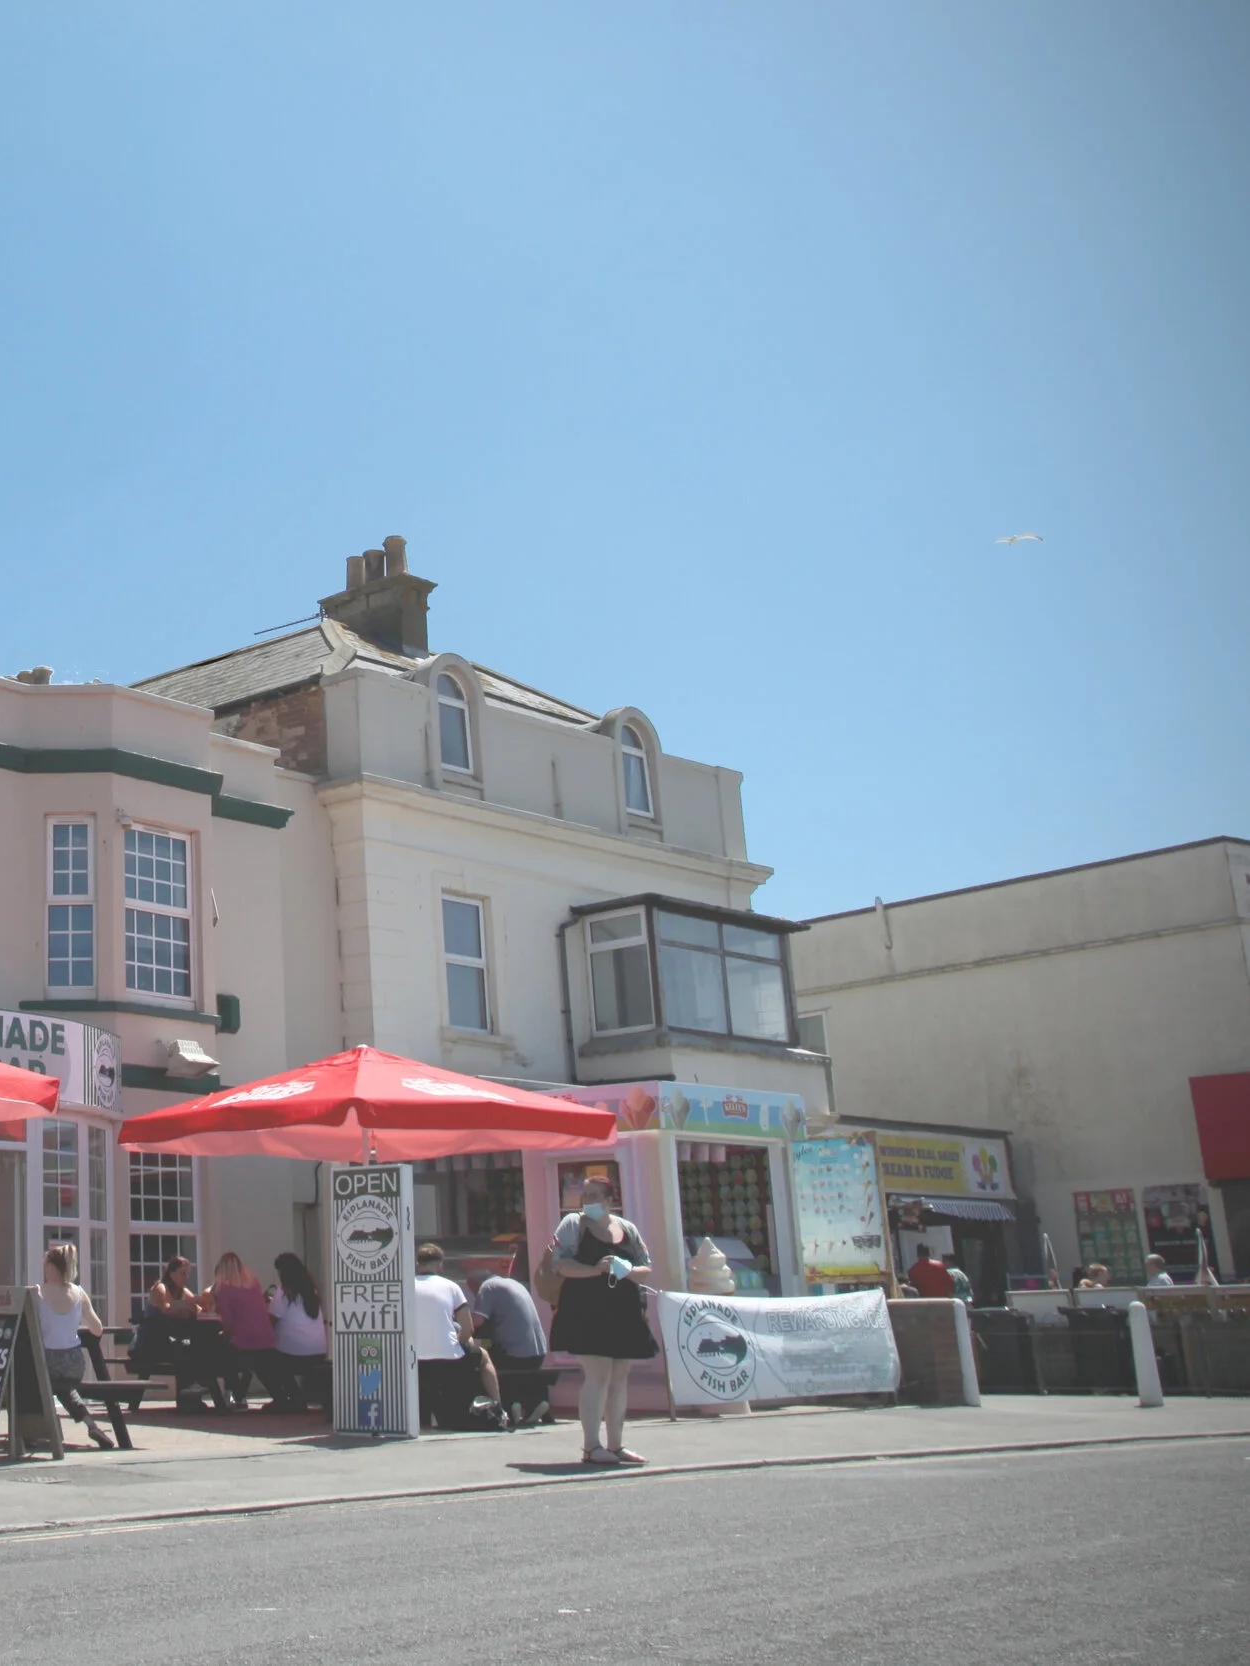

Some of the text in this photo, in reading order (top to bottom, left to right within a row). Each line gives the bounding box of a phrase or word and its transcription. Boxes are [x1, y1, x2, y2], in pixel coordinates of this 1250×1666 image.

[335, 1172, 397, 1195] OPEN
[343, 1199, 394, 1222] ESPLANADE
[346, 1253, 389, 1270] FISH BAR
[340, 1284, 400, 1303] FREE
[684, 1300, 738, 1327] ESPLANADE
[766, 1308, 861, 1333] REWARDING
[700, 1369, 749, 1393] FISH BAR
